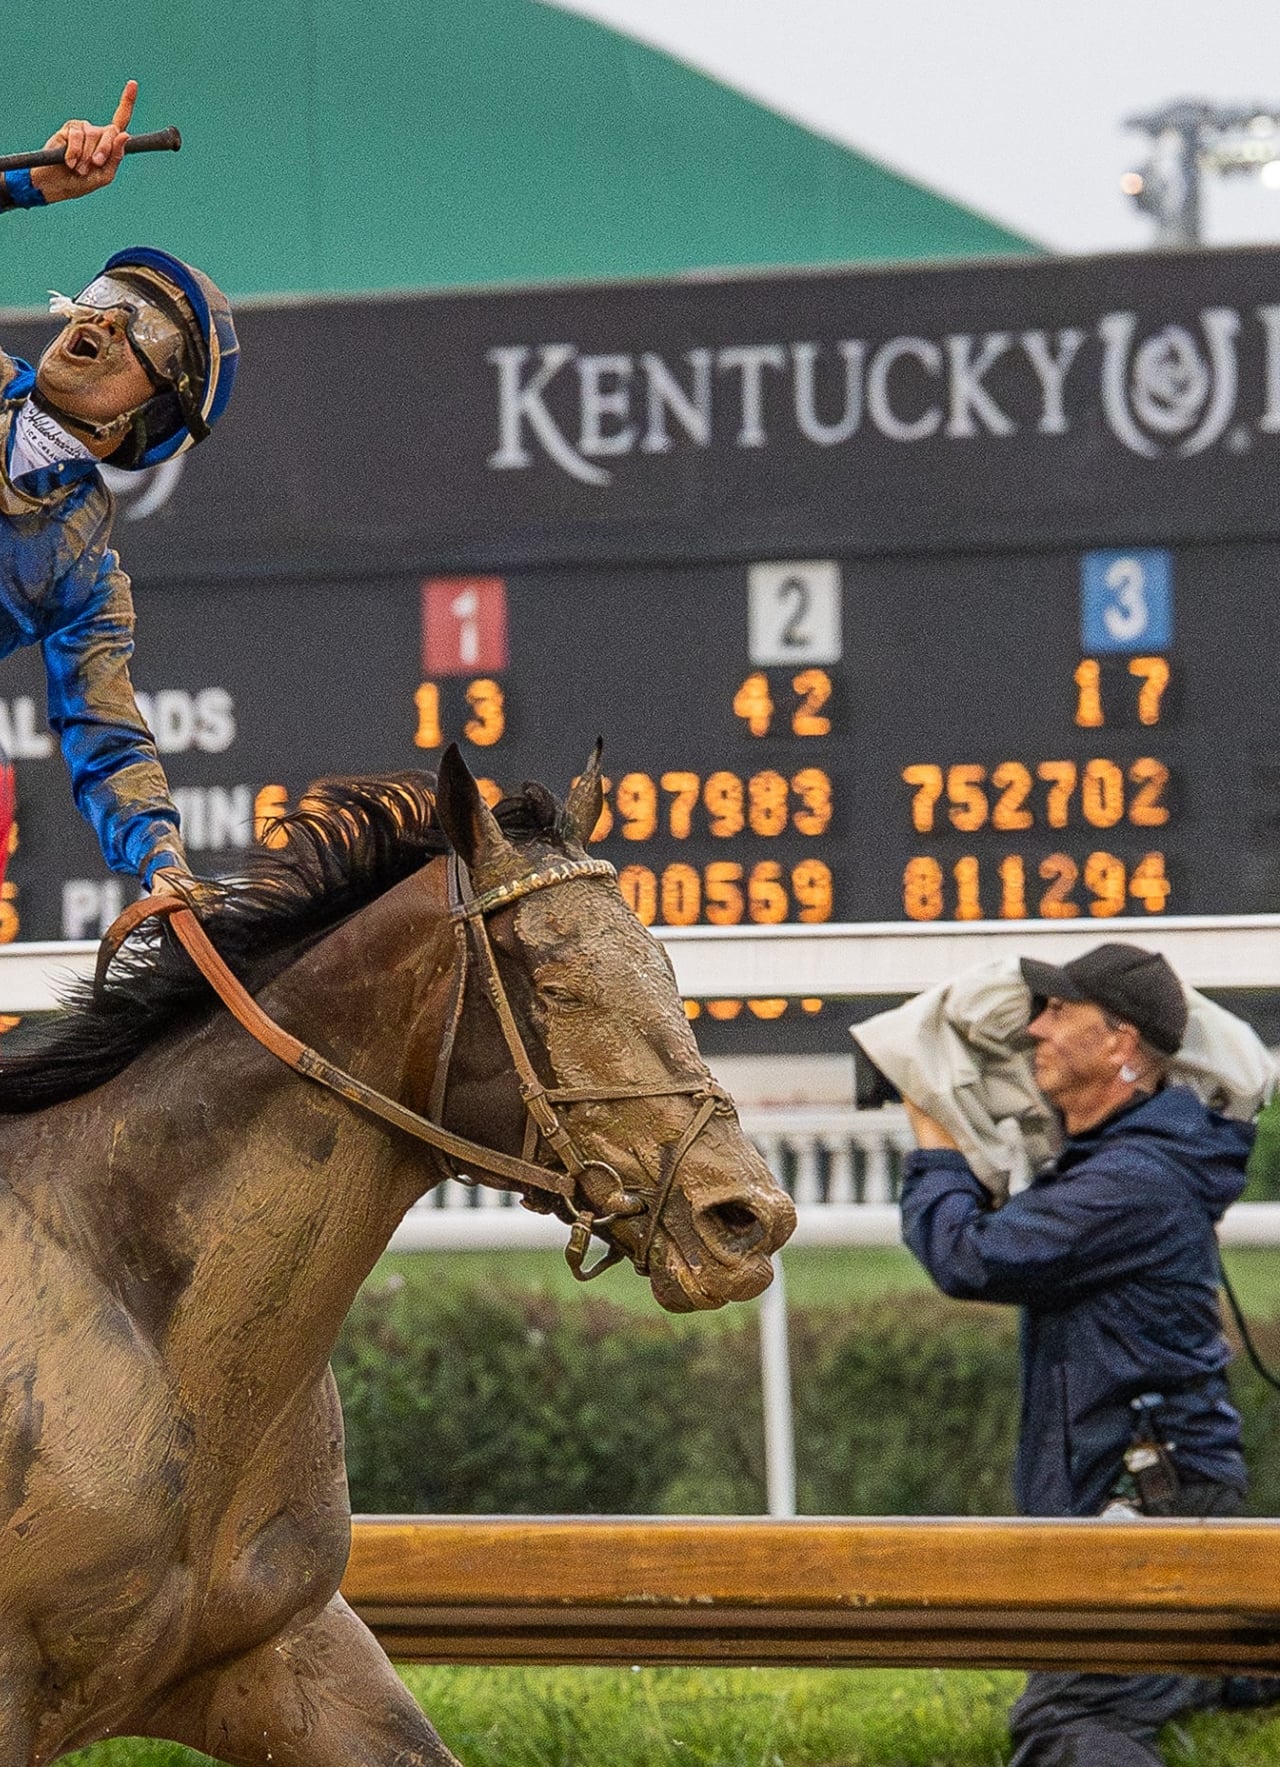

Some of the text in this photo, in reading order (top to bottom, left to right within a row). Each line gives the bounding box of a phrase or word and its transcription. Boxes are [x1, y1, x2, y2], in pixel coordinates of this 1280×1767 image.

[488, 328, 1086, 486] KENTUCKY
[451, 590, 479, 665] 1
[778, 575, 810, 648] 2
[1104, 558, 1148, 641] 3
[902, 757, 1169, 832] 752702
[902, 851, 1171, 921] 811294
